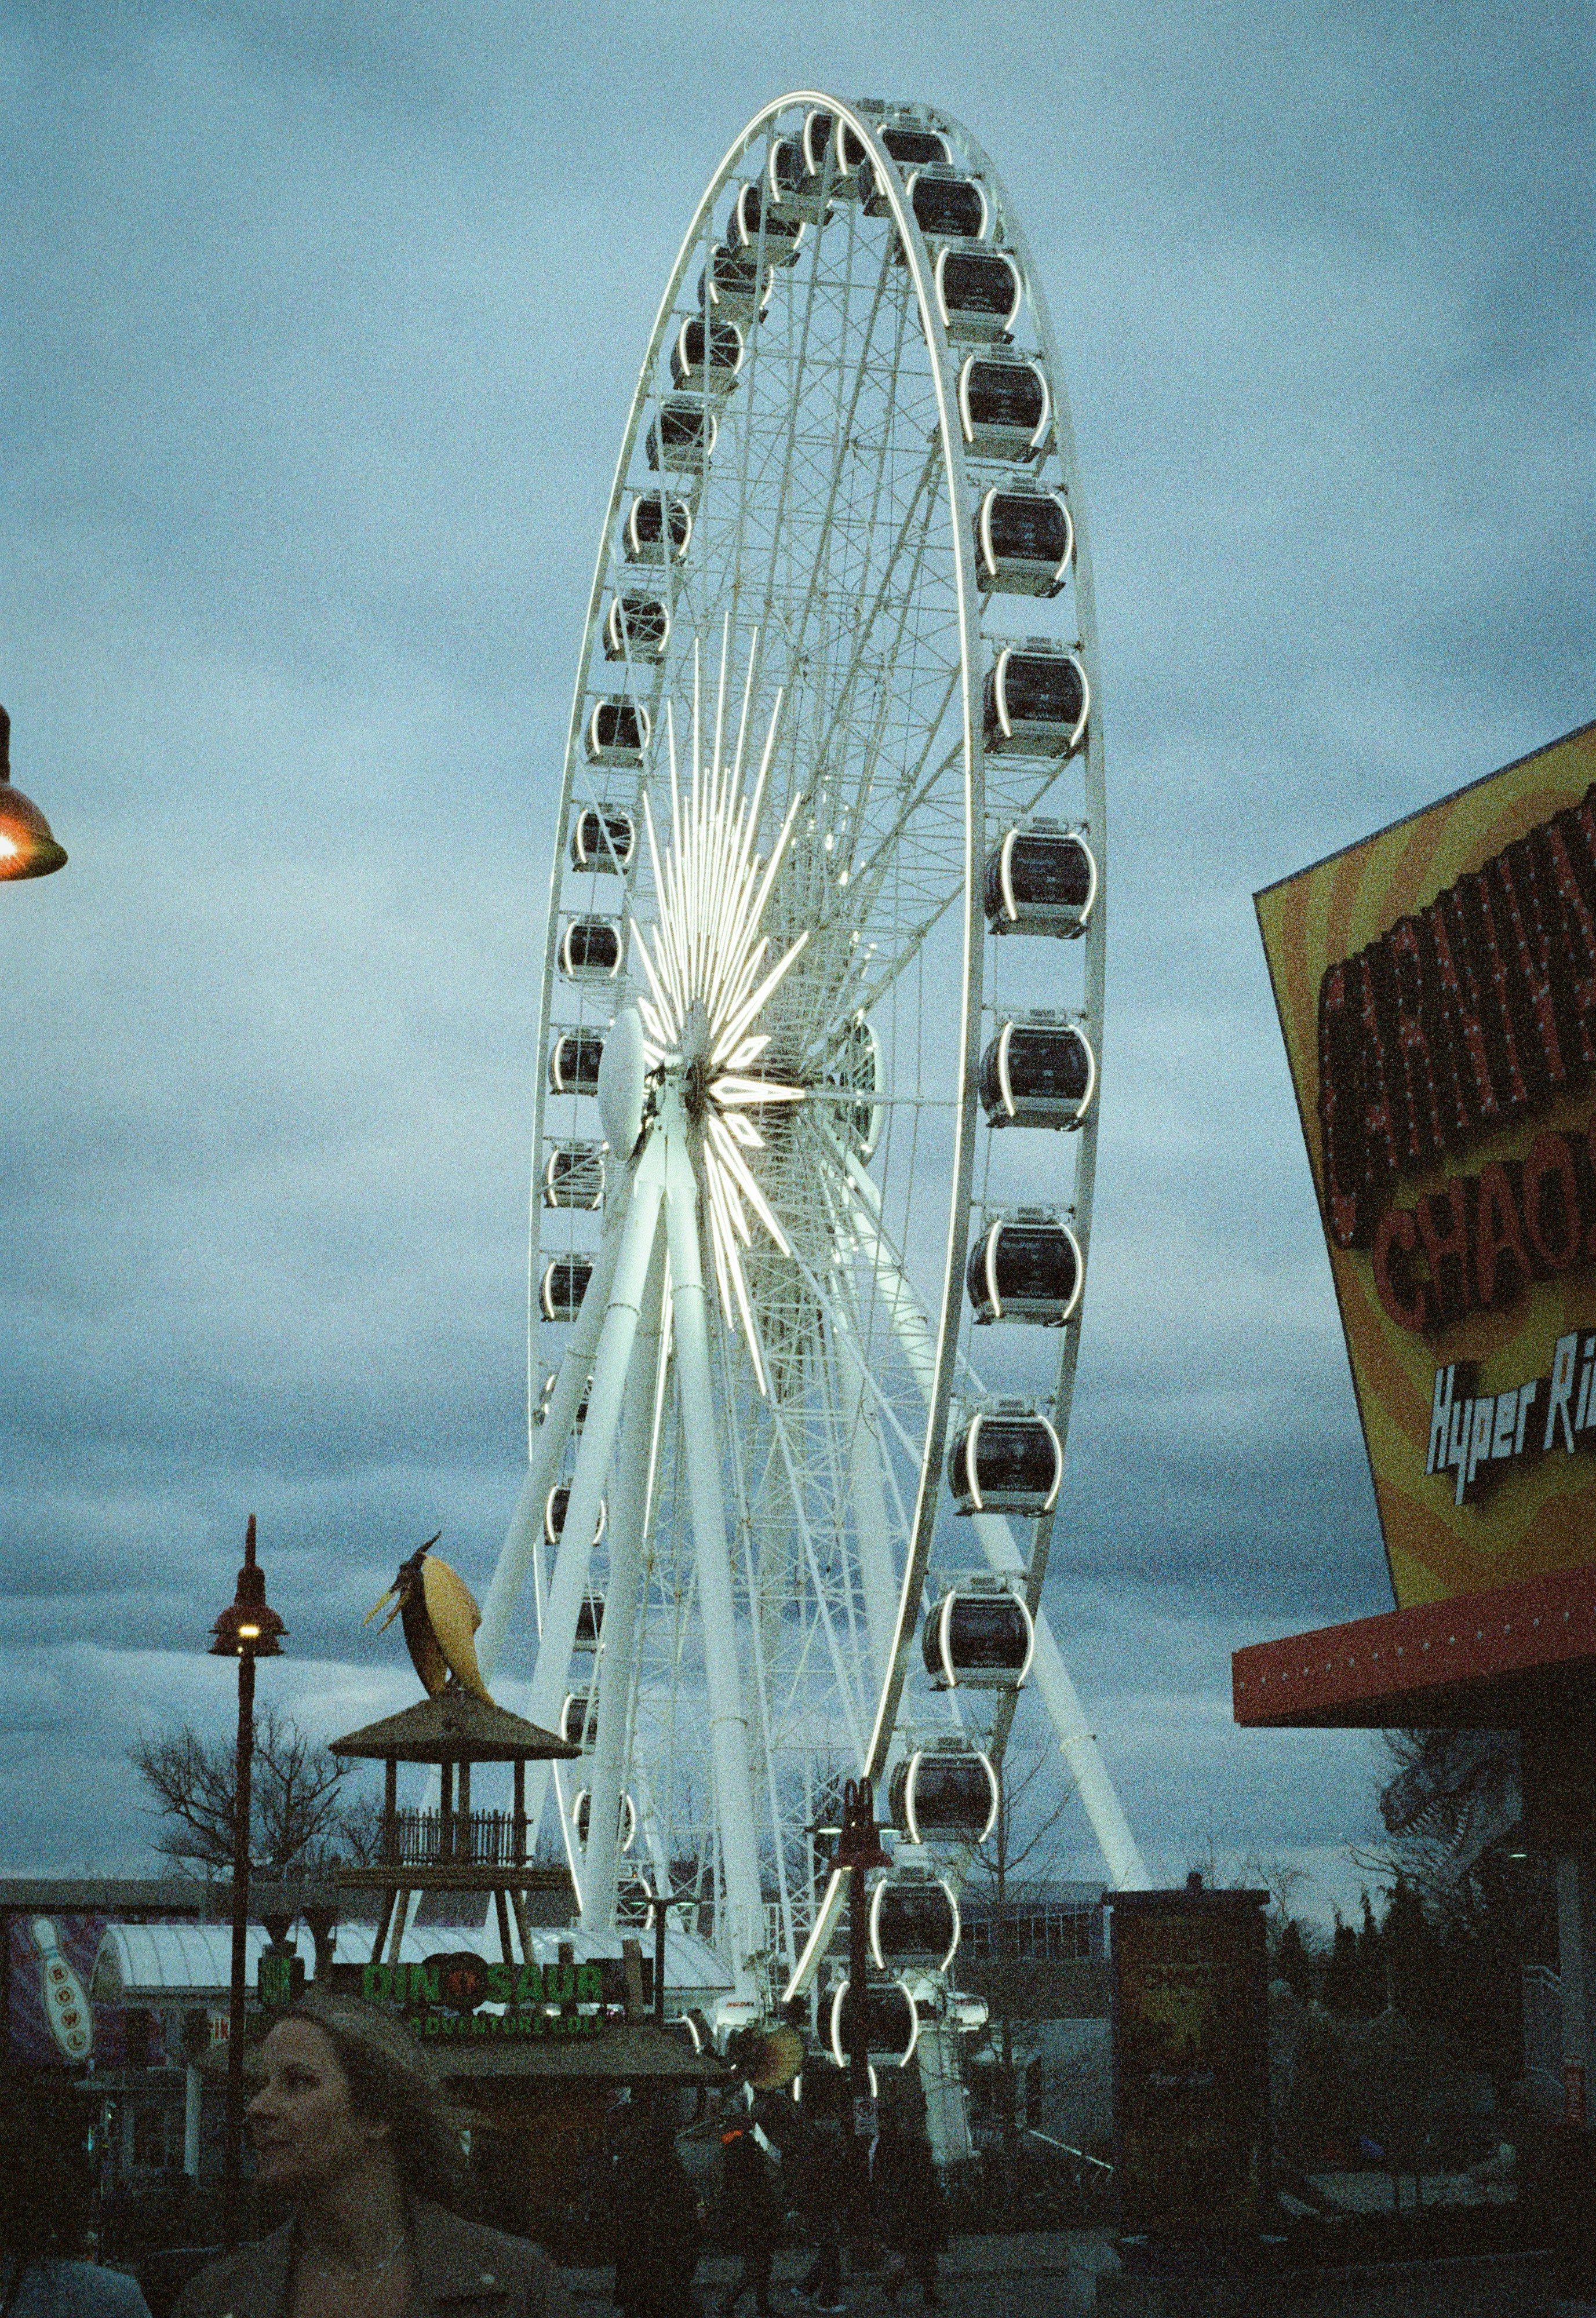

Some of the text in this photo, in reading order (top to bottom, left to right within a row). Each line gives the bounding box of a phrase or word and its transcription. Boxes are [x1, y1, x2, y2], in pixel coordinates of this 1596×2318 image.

[1322, 803, 1596, 1246] CARNIVA
[1372, 1113, 1596, 1333] CHAO
[1425, 1331, 1596, 1506] Hyper Ri
